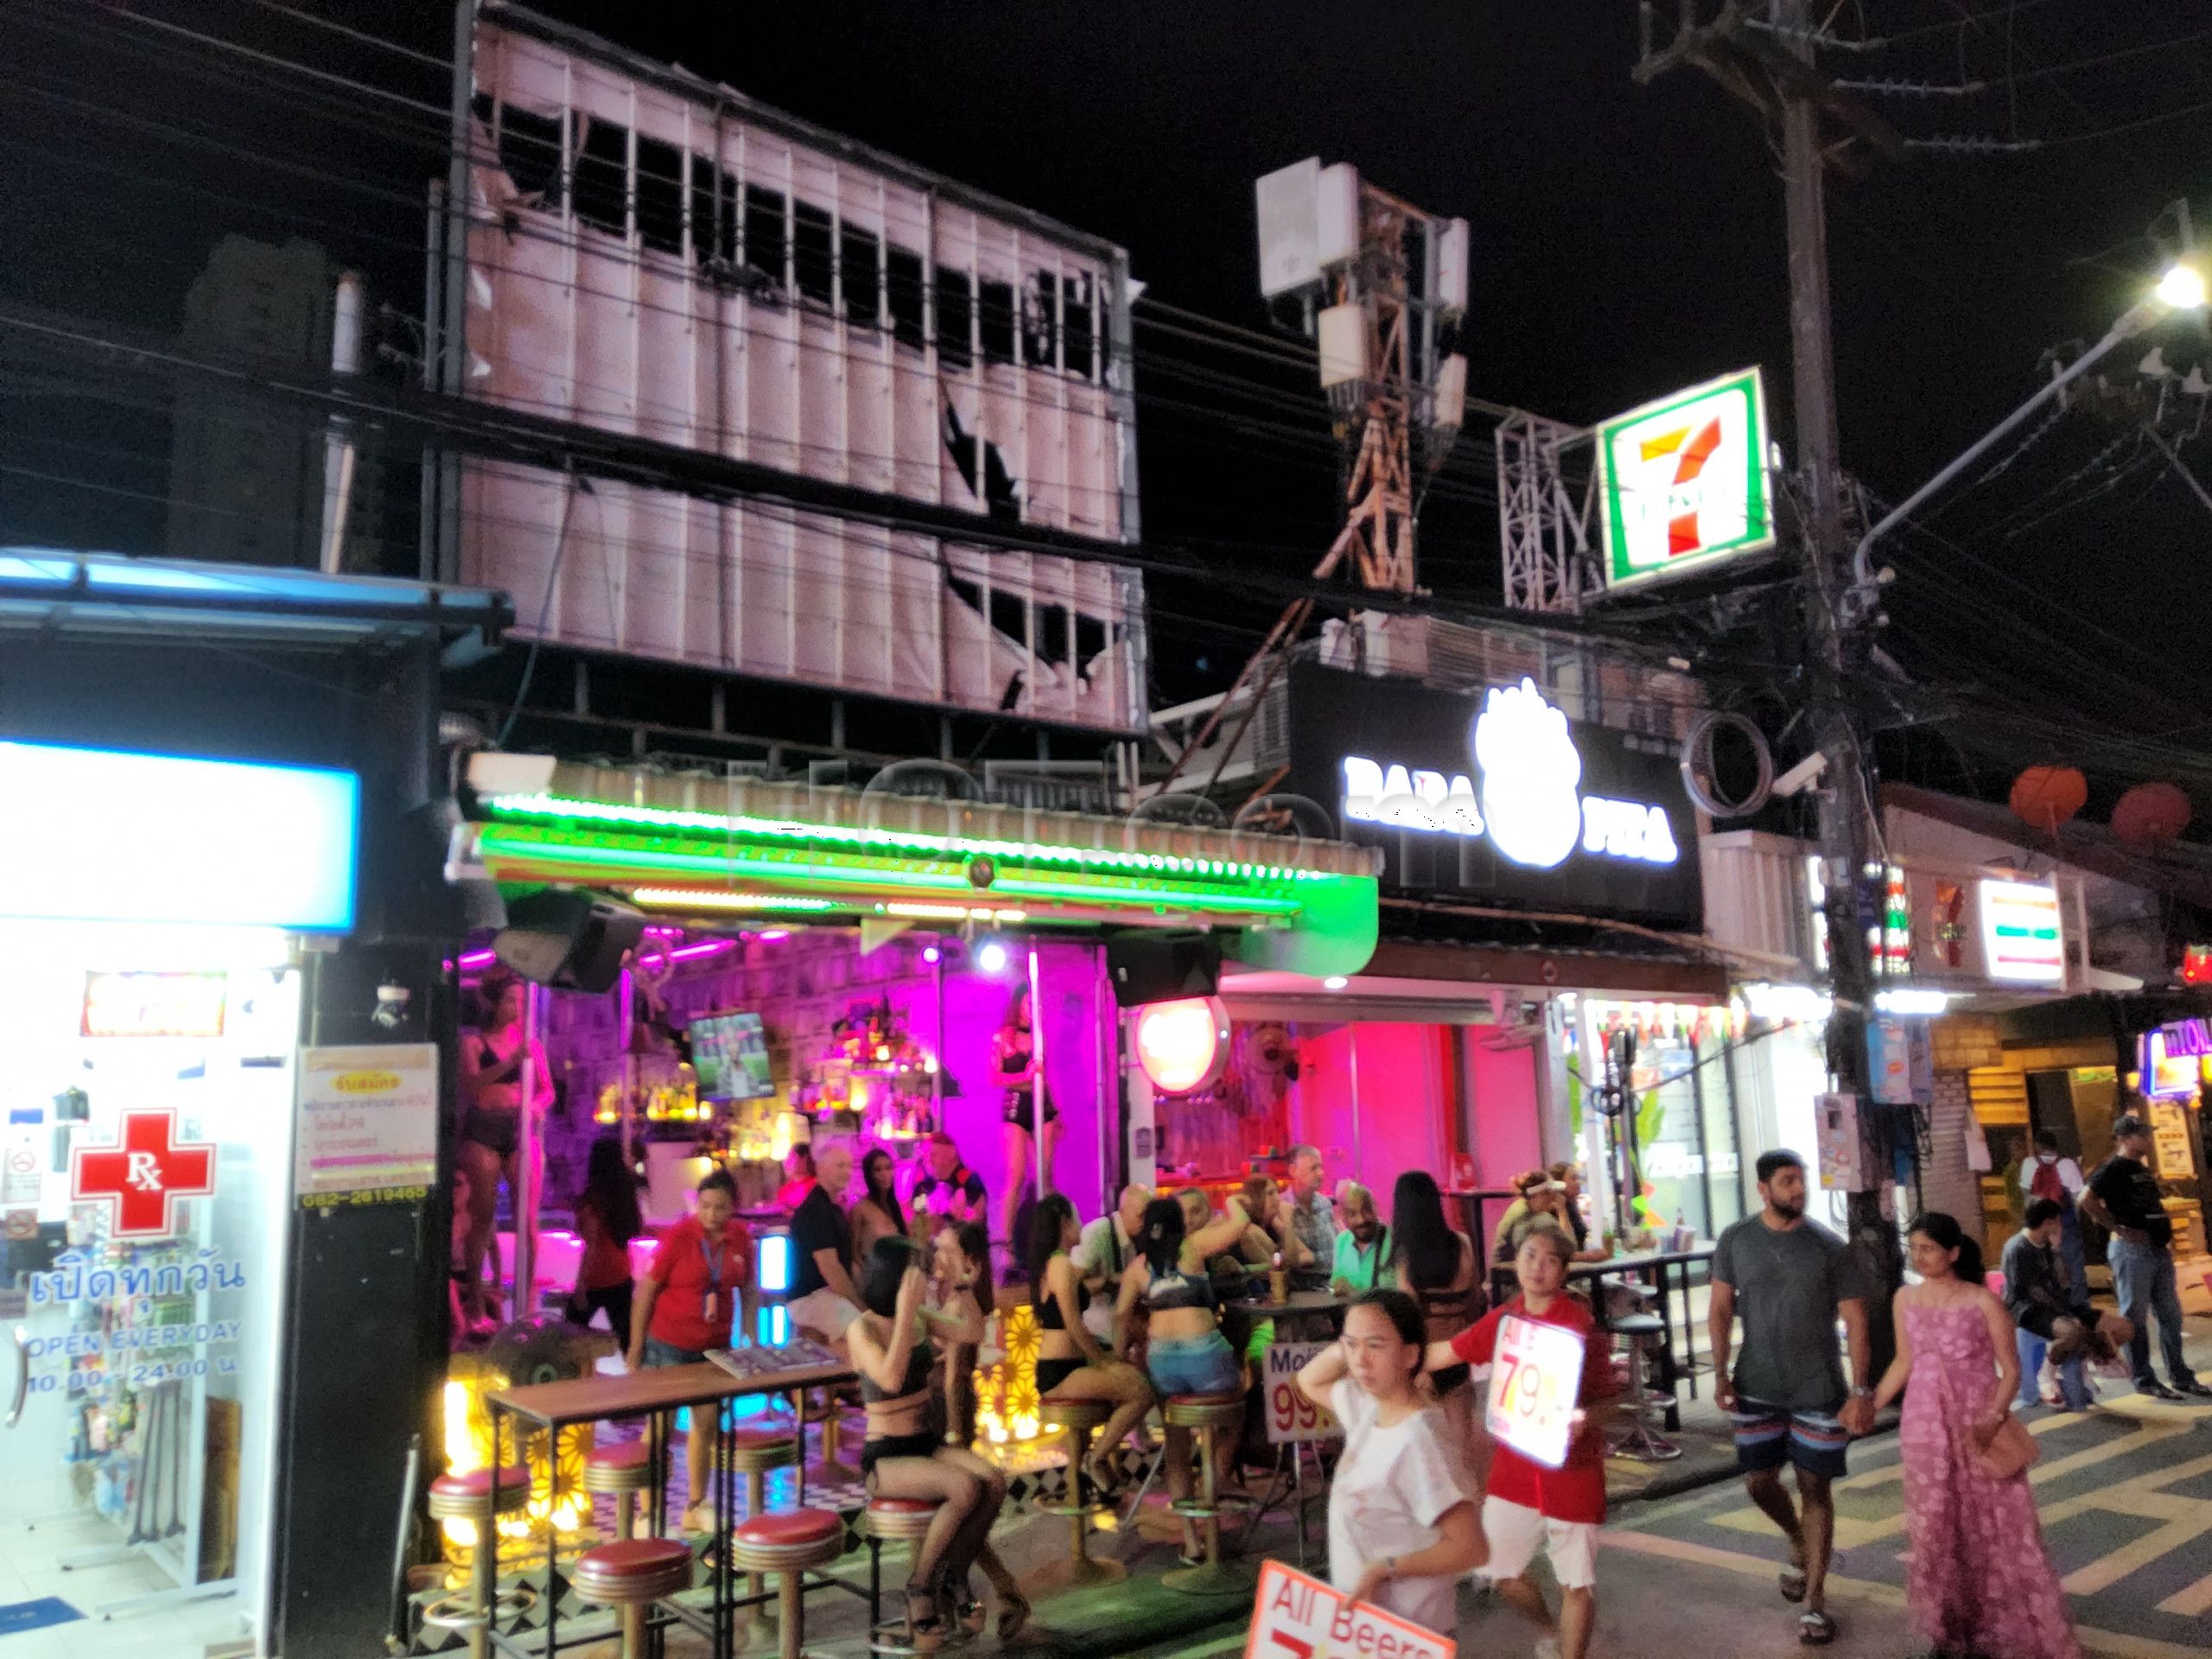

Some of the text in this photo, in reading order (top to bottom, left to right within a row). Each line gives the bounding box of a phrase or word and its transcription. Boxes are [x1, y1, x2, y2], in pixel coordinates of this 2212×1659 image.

[30, 1248, 245, 1313] เปิดทุกวัน
[27, 1321, 243, 1358] OPEN EVERYDAY
[1271, 1576, 1317, 1628] All
